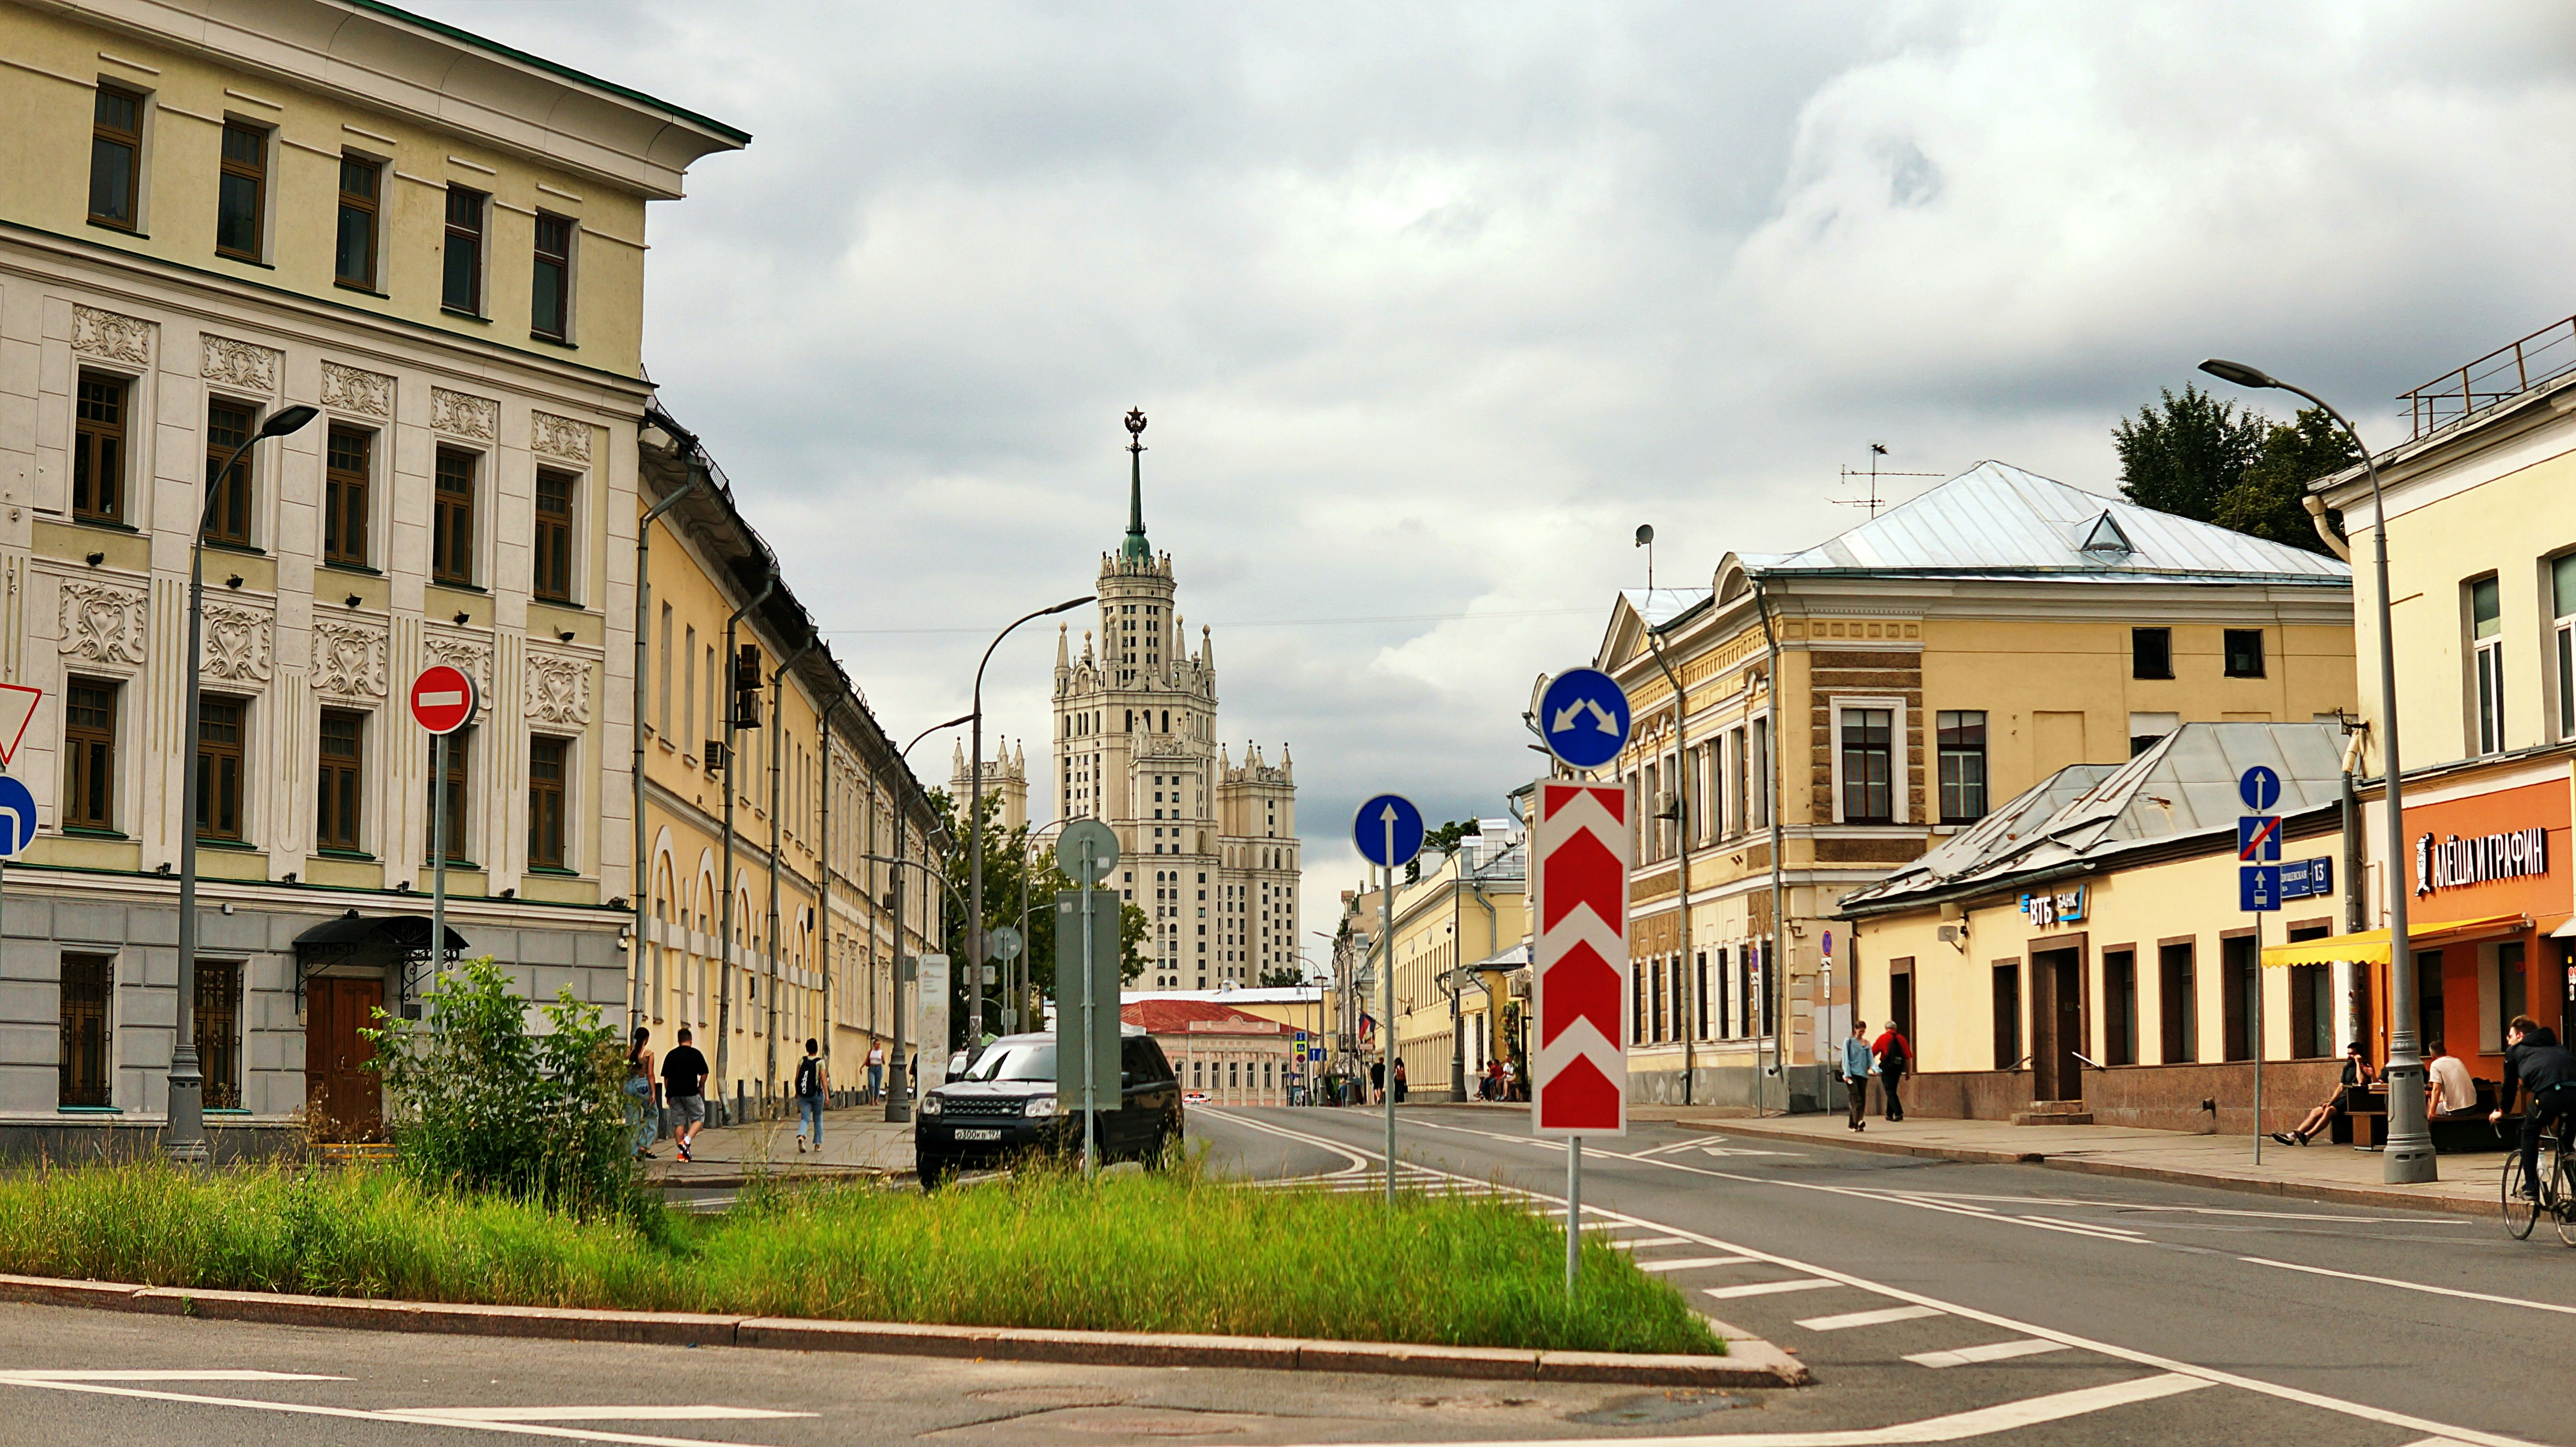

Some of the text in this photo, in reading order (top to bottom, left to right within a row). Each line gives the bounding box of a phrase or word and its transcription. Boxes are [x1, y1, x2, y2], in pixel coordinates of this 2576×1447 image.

[2314, 863, 2324, 881] 13
[2434, 827, 2543, 888] АЛЁША И ГРАФИН
[2030, 892, 2077, 926] ВТБ БАНК
